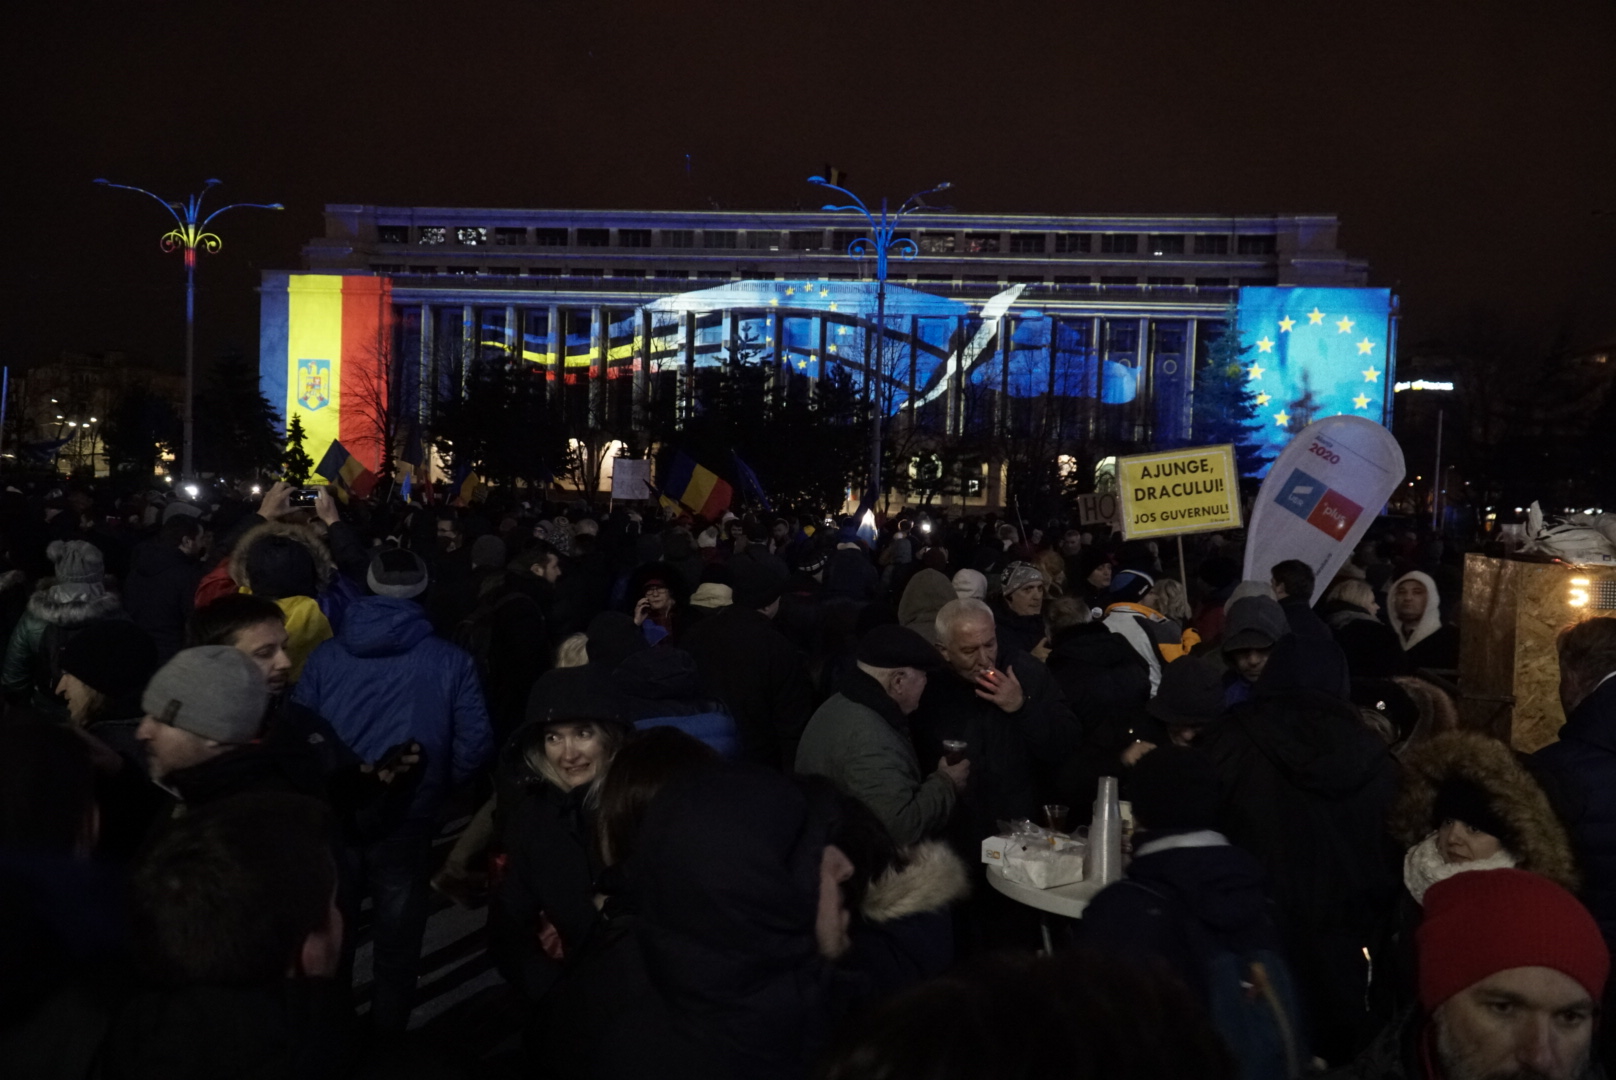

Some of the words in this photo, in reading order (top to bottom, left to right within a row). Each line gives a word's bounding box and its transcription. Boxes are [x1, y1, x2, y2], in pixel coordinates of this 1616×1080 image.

[1308, 442, 1341, 465] 2020
[1141, 458, 1214, 480] AJUNGE,
[1134, 478, 1224, 502] DRACULUI!
[1084, 493, 1116, 521] HO
[1134, 512, 1157, 525] JOS
[1160, 503, 1230, 522] GUVERNUL!
